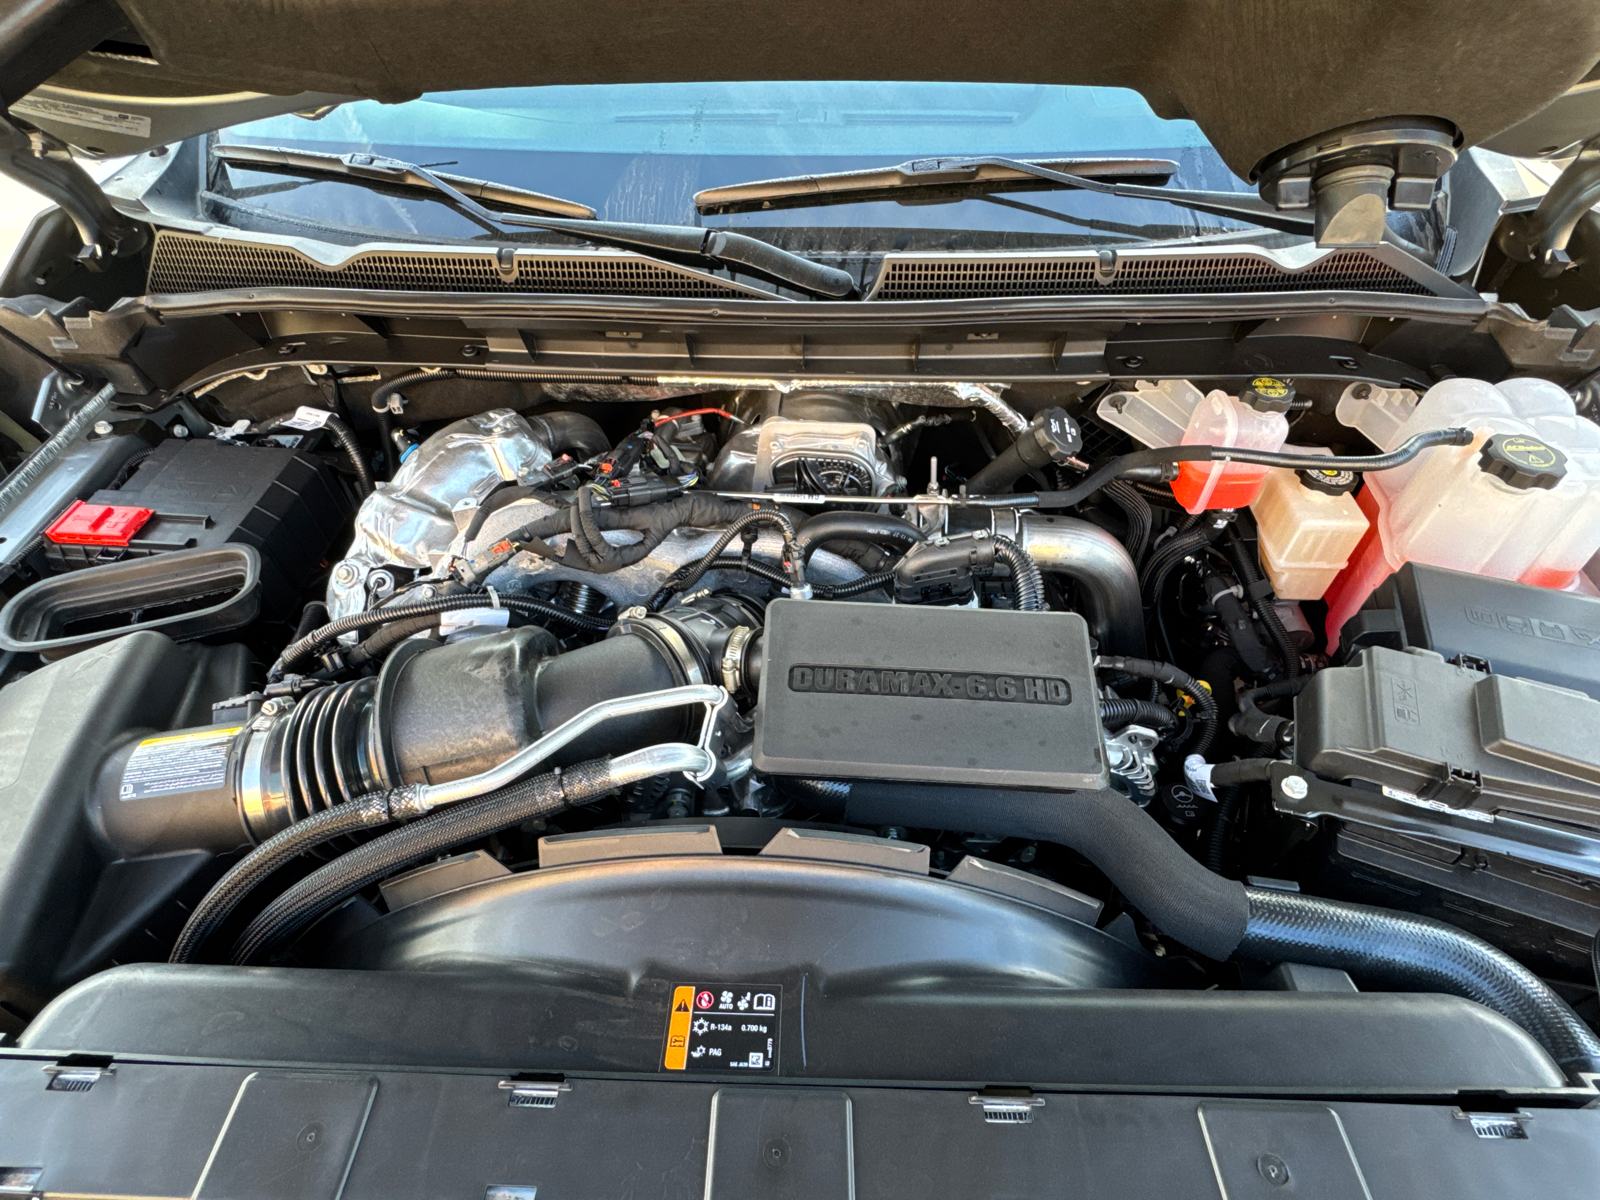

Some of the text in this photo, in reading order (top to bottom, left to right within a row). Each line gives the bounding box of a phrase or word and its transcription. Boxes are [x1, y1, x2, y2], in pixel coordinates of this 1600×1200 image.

[792, 667, 1068, 701] DURAMAX 6.6 HD
[710, 1023, 768, 1034] R-134a 0.700 kg
[708, 1048, 722, 1056] PAG
